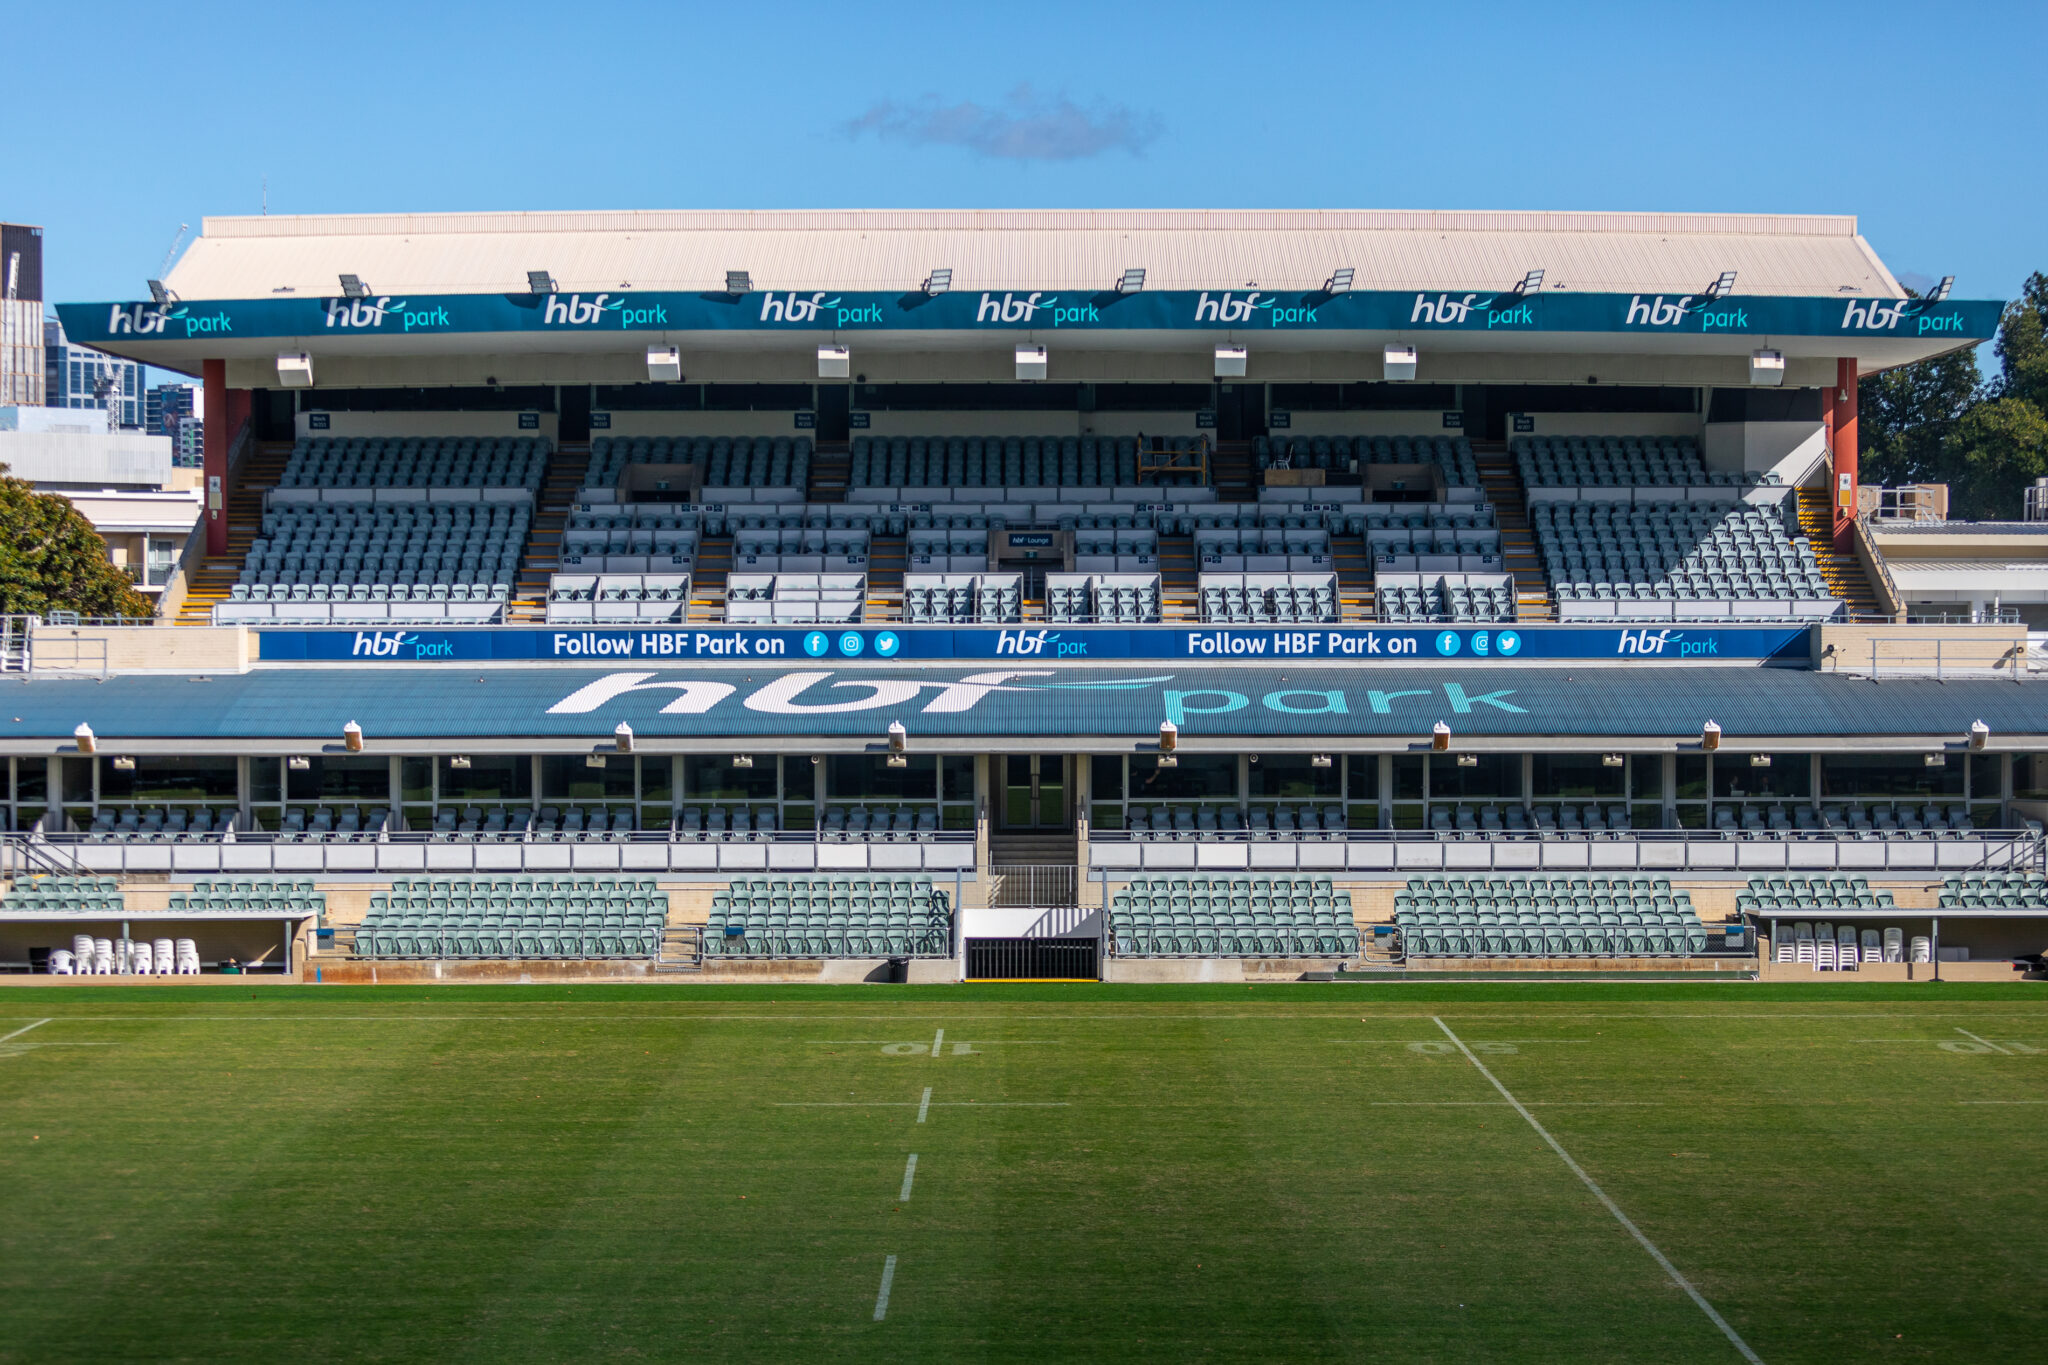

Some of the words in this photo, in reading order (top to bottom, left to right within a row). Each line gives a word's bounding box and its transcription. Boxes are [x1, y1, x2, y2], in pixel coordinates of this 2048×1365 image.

[109, 303, 172, 334] hbf
[185, 311, 233, 338] park
[326, 296, 391, 328] hbf
[403, 305, 450, 332] park
[544, 293, 609, 324] hbf
[622, 303, 668, 329] park
[759, 291, 826, 322] hbf
[837, 302, 883, 328] park
[976, 291, 1042, 322] hbf
[1054, 302, 1100, 328] park
[1194, 291, 1261, 322] hbf
[1272, 302, 1317, 328] park
[1410, 292, 1477, 323] hbf
[1488, 304, 1533, 329] park
[1625, 295, 1692, 325] hbf
[1702, 307, 1748, 332] park
[1841, 298, 1908, 329] hbf
[1918, 311, 1964, 336] park
[1027, 537, 1049, 545] Lounge
[352, 630, 406, 655] hbf
[416, 639, 454, 661] park
[554, 632, 635, 656] Follow
[641, 633, 689, 655] HBF
[695, 632, 749, 655] Park
[755, 638, 785, 655] on
[996, 629, 1048, 655] hbf
[1188, 631, 1267, 654] Follow
[1274, 632, 1321, 654] HBF
[1328, 631, 1382, 654] Park
[1387, 637, 1417, 654] on
[1617, 628, 1671, 654] hbf
[1680, 637, 1718, 659] park
[545, 671, 1056, 715] hbf
[1162, 682, 1530, 726] park
